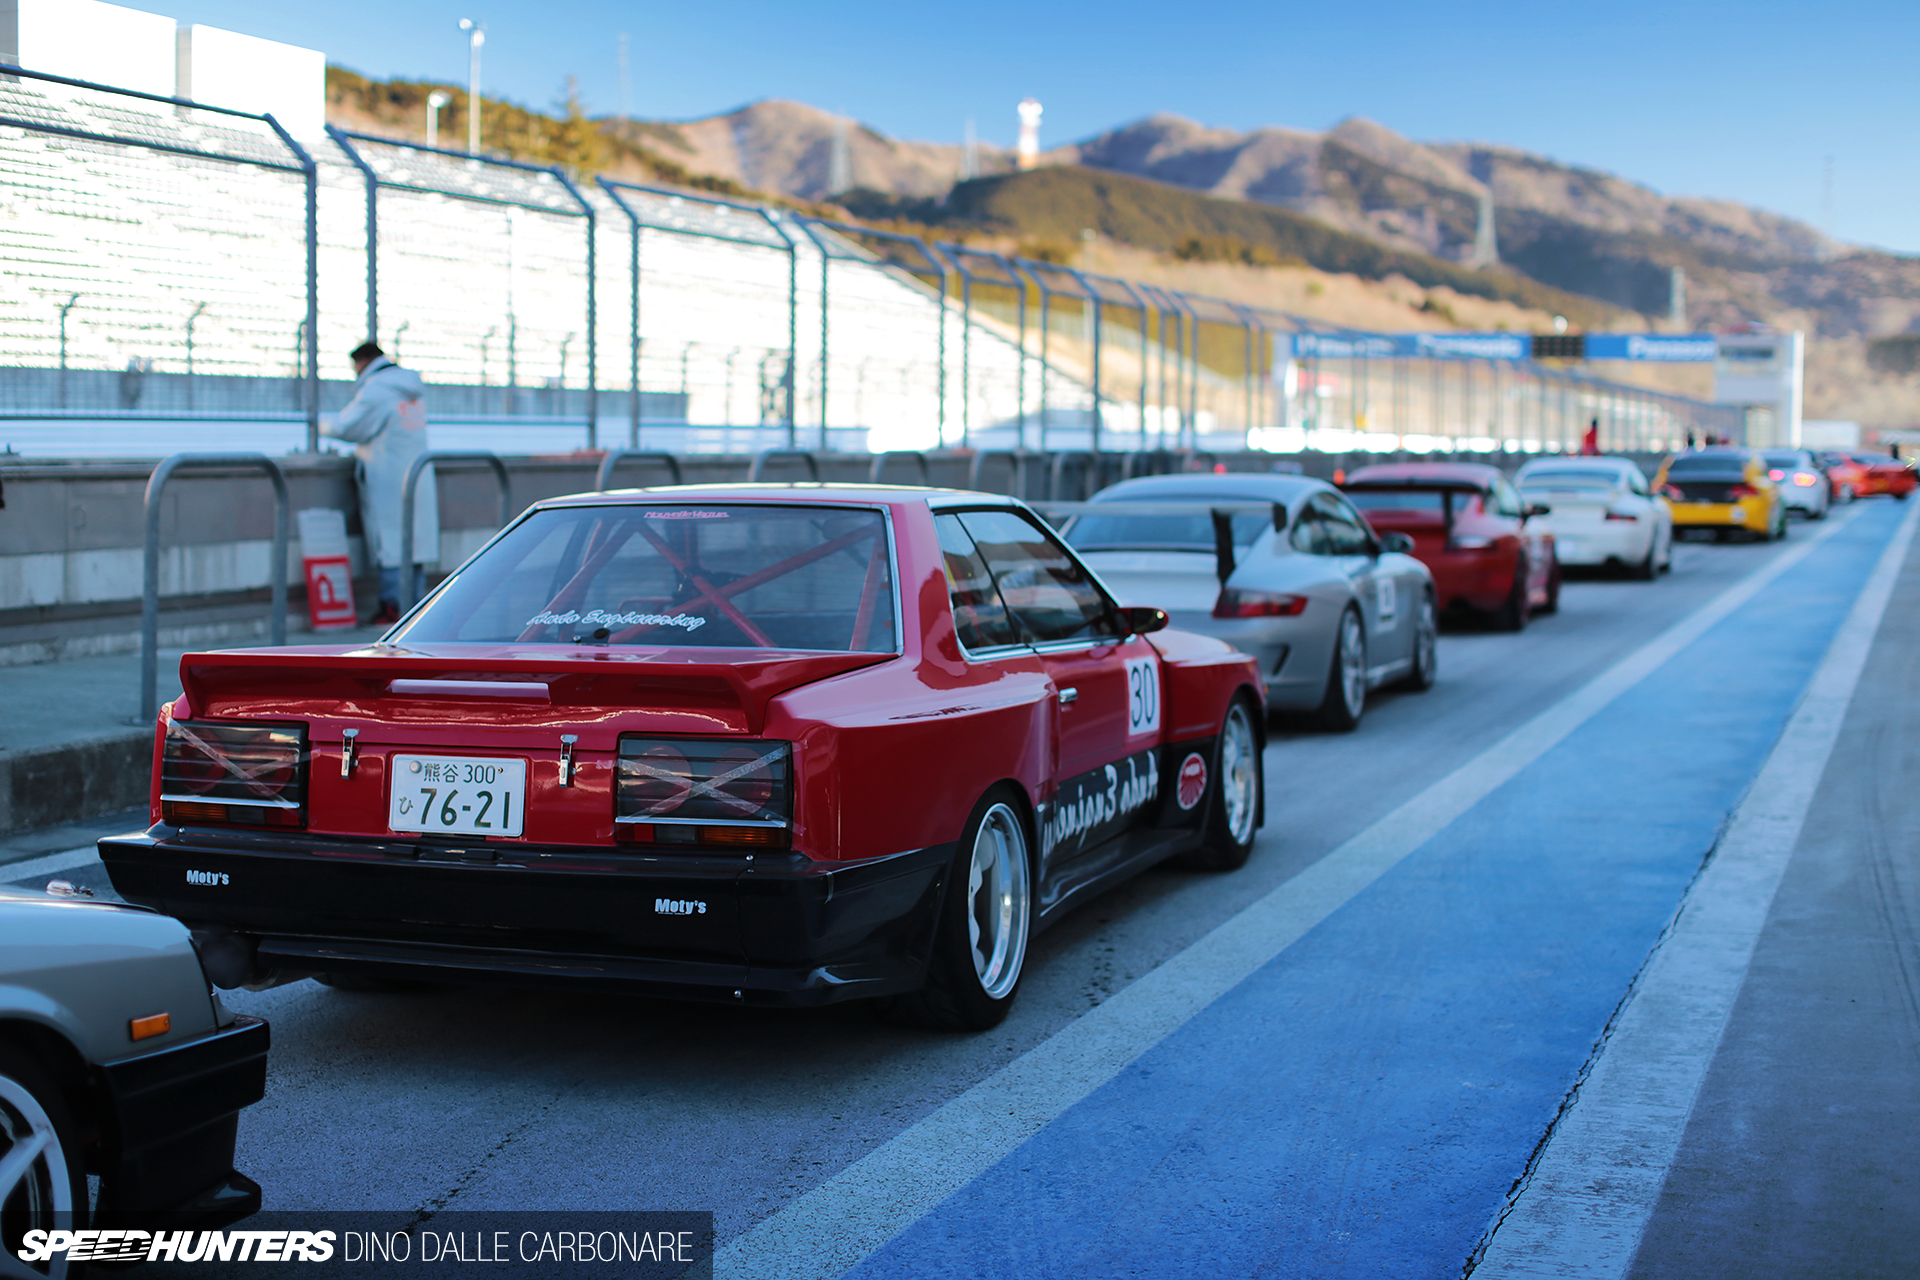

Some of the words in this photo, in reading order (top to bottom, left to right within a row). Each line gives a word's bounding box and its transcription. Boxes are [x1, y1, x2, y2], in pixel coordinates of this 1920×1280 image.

[581, 609, 706, 632] Engineering
[1130, 662, 1156, 728] 30
[424, 762, 459, 783] 熊谷
[463, 764, 496, 785] 300
[399, 796, 414, 815] ひ
[420, 788, 511, 829] 76-21
[186, 869, 230, 886] Moty's
[654, 898, 707, 915] Moty's
